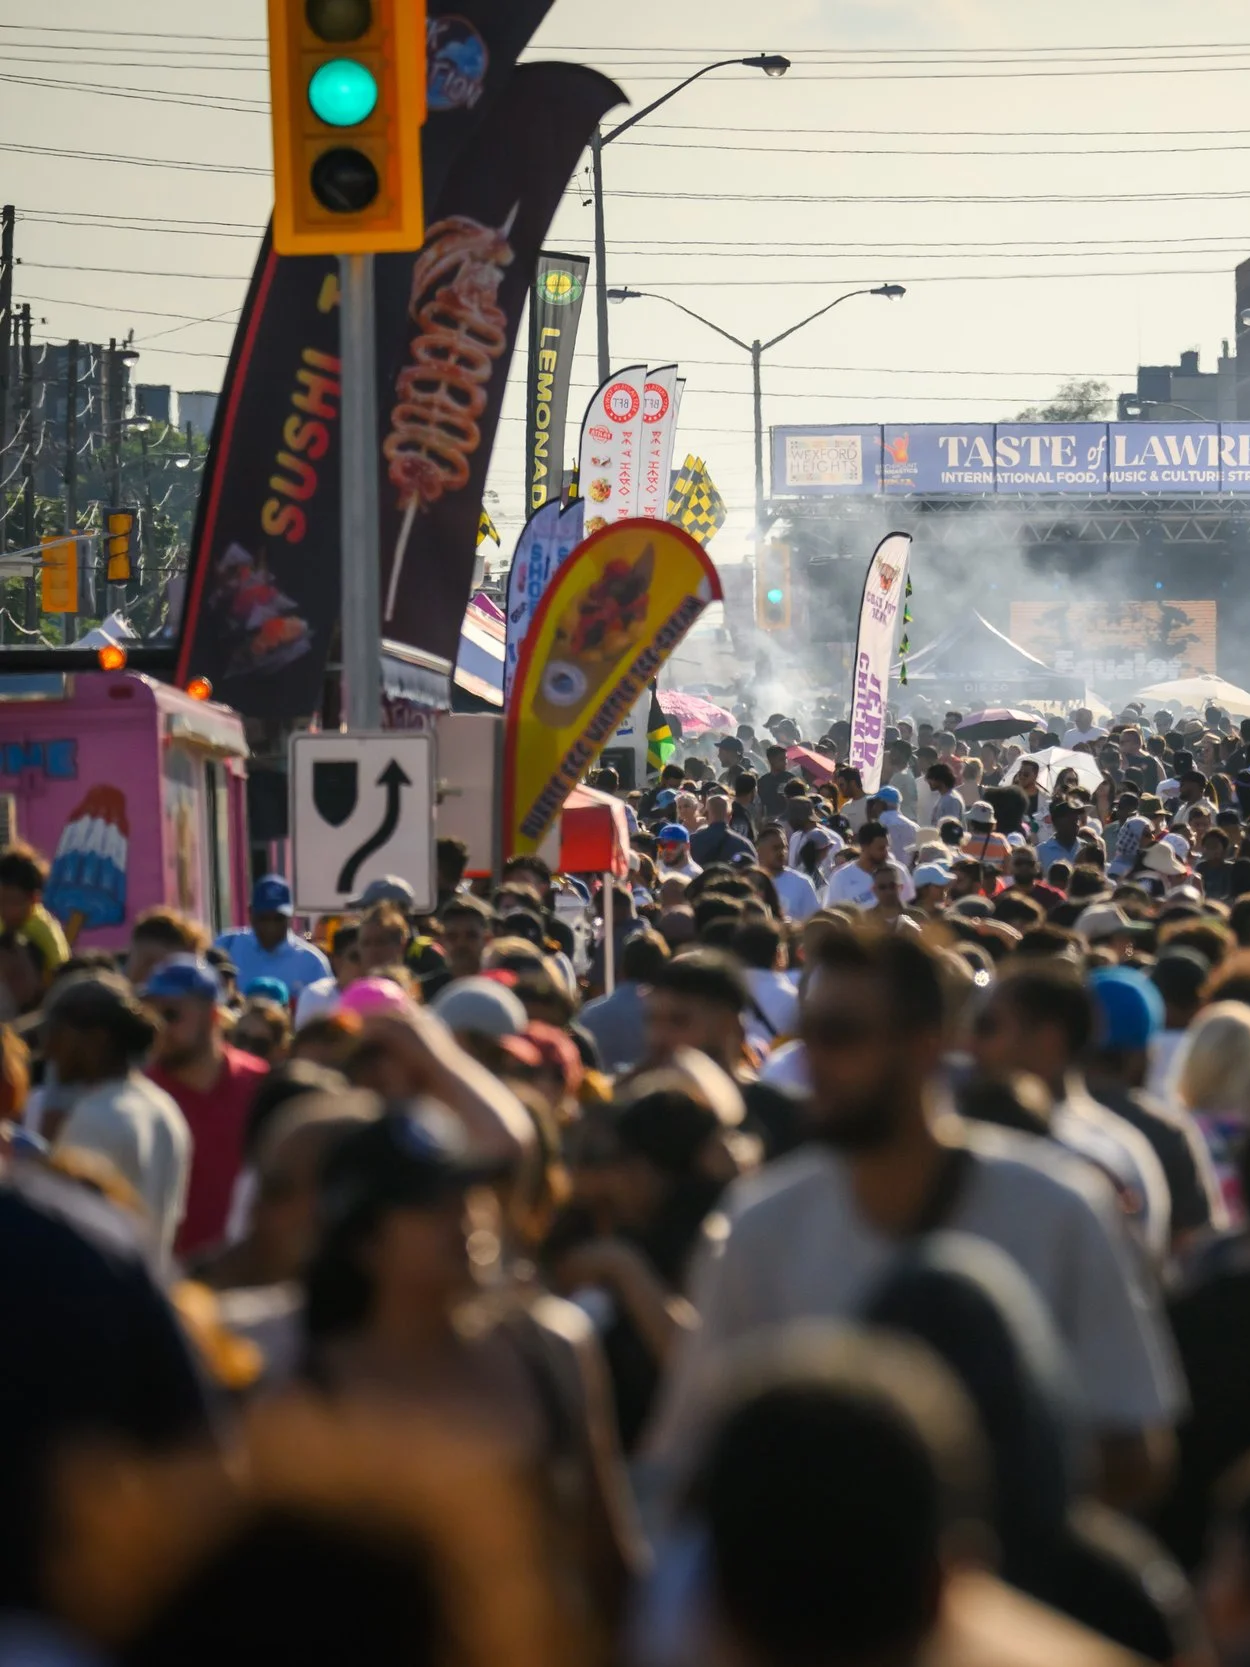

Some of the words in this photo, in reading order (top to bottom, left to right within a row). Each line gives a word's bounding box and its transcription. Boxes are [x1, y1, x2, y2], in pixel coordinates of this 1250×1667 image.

[531, 326, 561, 510] LEMONAD
[261, 347, 341, 544] SUSHI
[791, 448, 858, 461] WEXFORD
[939, 435, 1077, 467] TASTE
[1087, 436, 1107, 470] of
[790, 460, 858, 473] HEIGHTS
[941, 471, 1054, 484] INTERNATIONAL
[1056, 471, 1100, 485] FOOD,
[1103, 470, 1147, 483] MUSIC
[1150, 470, 1159, 482] &
[1162, 470, 1225, 482] CULTURE
[864, 673, 882, 768] JERK
